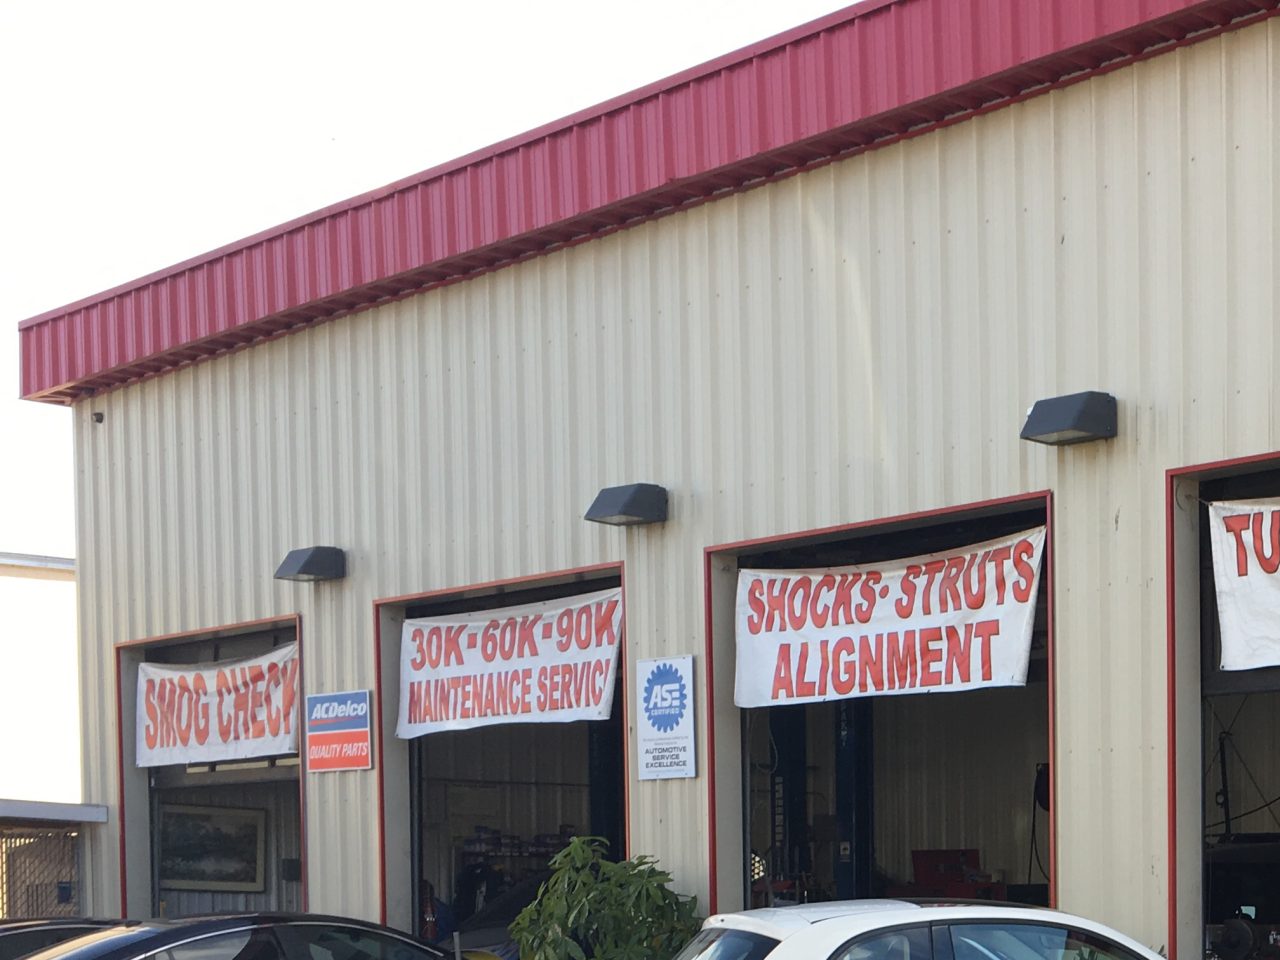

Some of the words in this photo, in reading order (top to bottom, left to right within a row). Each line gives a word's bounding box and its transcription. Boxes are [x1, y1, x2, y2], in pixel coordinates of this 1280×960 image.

[895, 539, 1035, 620] STRUTS
[771, 619, 1000, 700] ALIGNMENT
[408, 667, 533, 725] MAINTENANCE
[648, 682, 680, 709] ASE
[145, 672, 209, 750] SMOG
[311, 700, 367, 720] ACDelco
[310, 743, 341, 760] QUALITY
[342, 742, 368, 758] PARTS
[645, 747, 687, 755] AUTOMOTIVE
[652, 753, 680, 762] SERVICE
[645, 759, 687, 768] EXCELLENCE
